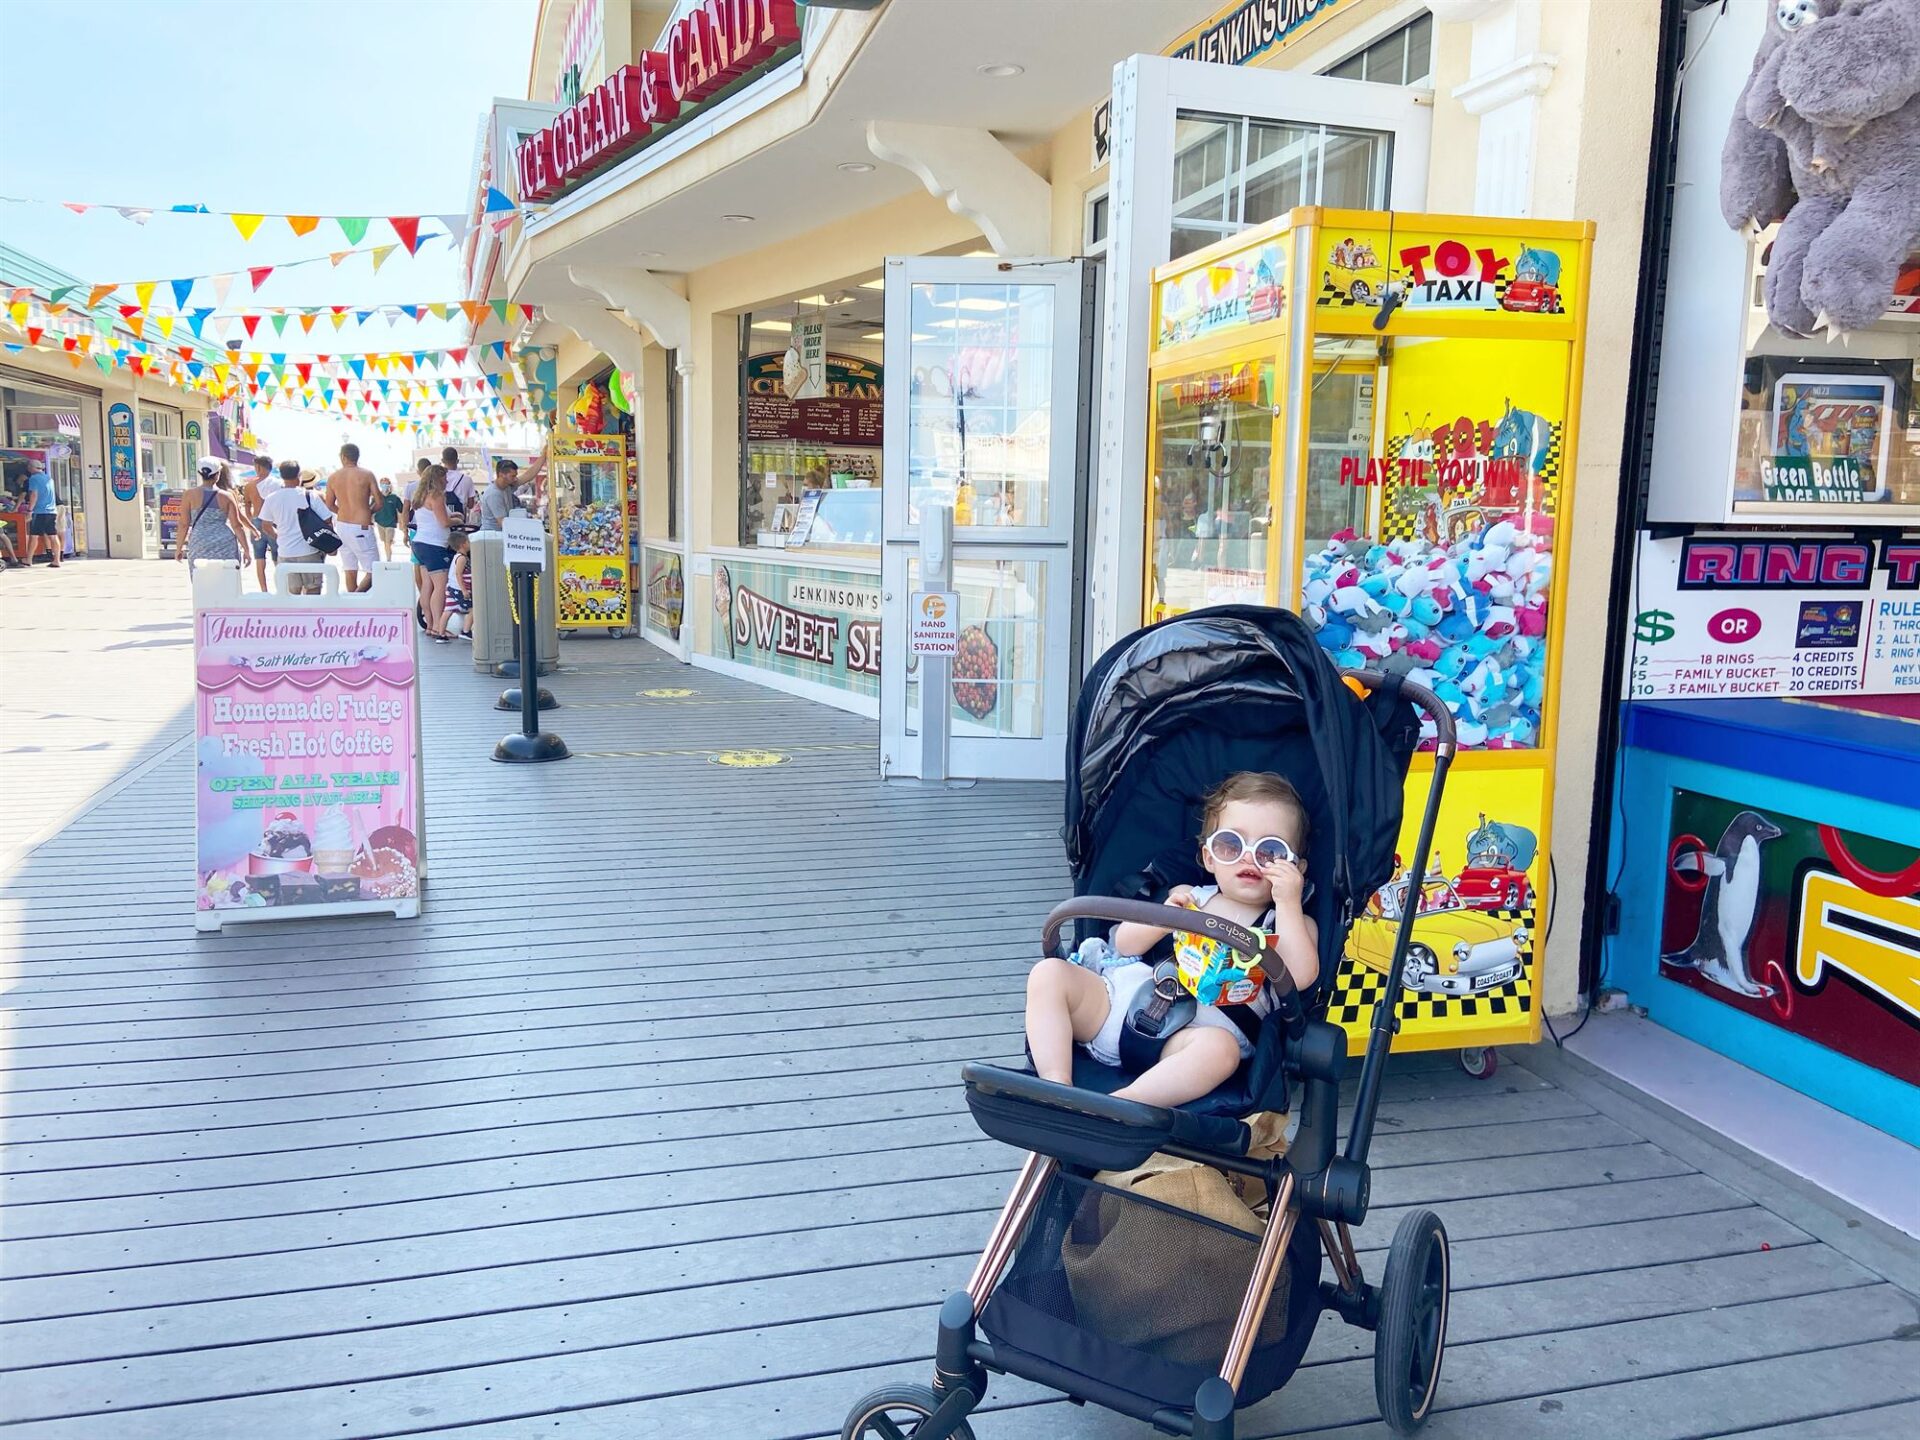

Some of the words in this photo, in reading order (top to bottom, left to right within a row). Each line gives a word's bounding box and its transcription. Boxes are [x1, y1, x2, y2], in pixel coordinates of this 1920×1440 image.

[516, 129, 548, 201] ICE
[552, 65, 631, 179] CREAM
[639, 49, 659, 123] &
[1400, 240, 1510, 287] TOY
[1423, 280, 1482, 302] TAXI
[1206, 297, 1239, 325] TAXI
[803, 324, 823, 336] PLEASE
[803, 336, 822, 347] ORDER
[805, 348, 820, 359] HERE
[1358, 433, 1371, 443] Pay
[1339, 457, 1391, 486] PLAY
[1398, 458, 1429, 487] TIL
[1437, 459, 1477, 488] YOU
[1483, 459, 1521, 488] WIN
[1760, 459, 1808, 486] Green
[1812, 459, 1860, 489] Bottle
[507, 542, 525, 550] Enter
[1684, 544, 1868, 584] RING
[792, 585, 878, 610] JENKINSON'S
[211, 616, 307, 643] Jenkinsons
[312, 615, 400, 643] Sweetshop
[735, 585, 839, 665] SWEET
[1633, 609, 1676, 646] $
[1720, 618, 1748, 635] OR
[913, 631, 955, 640] SANITIZER
[1893, 634, 1911, 645] ALL
[913, 643, 955, 652] STATION
[1891, 647, 1914, 659] RING
[255, 655, 281, 668] Salt
[282, 654, 318, 667] Water
[318, 650, 351, 665] Taffy
[1700, 654, 1713, 665] 18
[1716, 653, 1755, 665] RINGS
[1792, 651, 1801, 663] 4
[1804, 651, 1854, 663] CREDITS
[1675, 668, 1723, 680] FAMILY
[1726, 667, 1776, 679] BUCKET
[1791, 666, 1804, 677] 10
[1807, 665, 1858, 677] CREDITS
[1893, 664, 1915, 674] ANY
[1667, 683, 1676, 694] 3
[1679, 682, 1727, 694] FAMILY
[1729, 681, 1780, 693] BUCKET
[1788, 680, 1804, 691] 20
[1807, 679, 1858, 691] CREDITS
[212, 694, 335, 724] Homemade
[336, 693, 403, 725] Fudge
[221, 731, 285, 760] Fresh
[287, 729, 327, 758] Hot
[329, 728, 394, 757] Coffee
[209, 774, 277, 793] OPEN
[279, 773, 328, 789] ALL
[329, 770, 400, 787] YEAR!
[231, 793, 301, 810] SHIPPING
[1218, 921, 1252, 944] cybex
[1476, 969, 1513, 987] COAST2COAST
